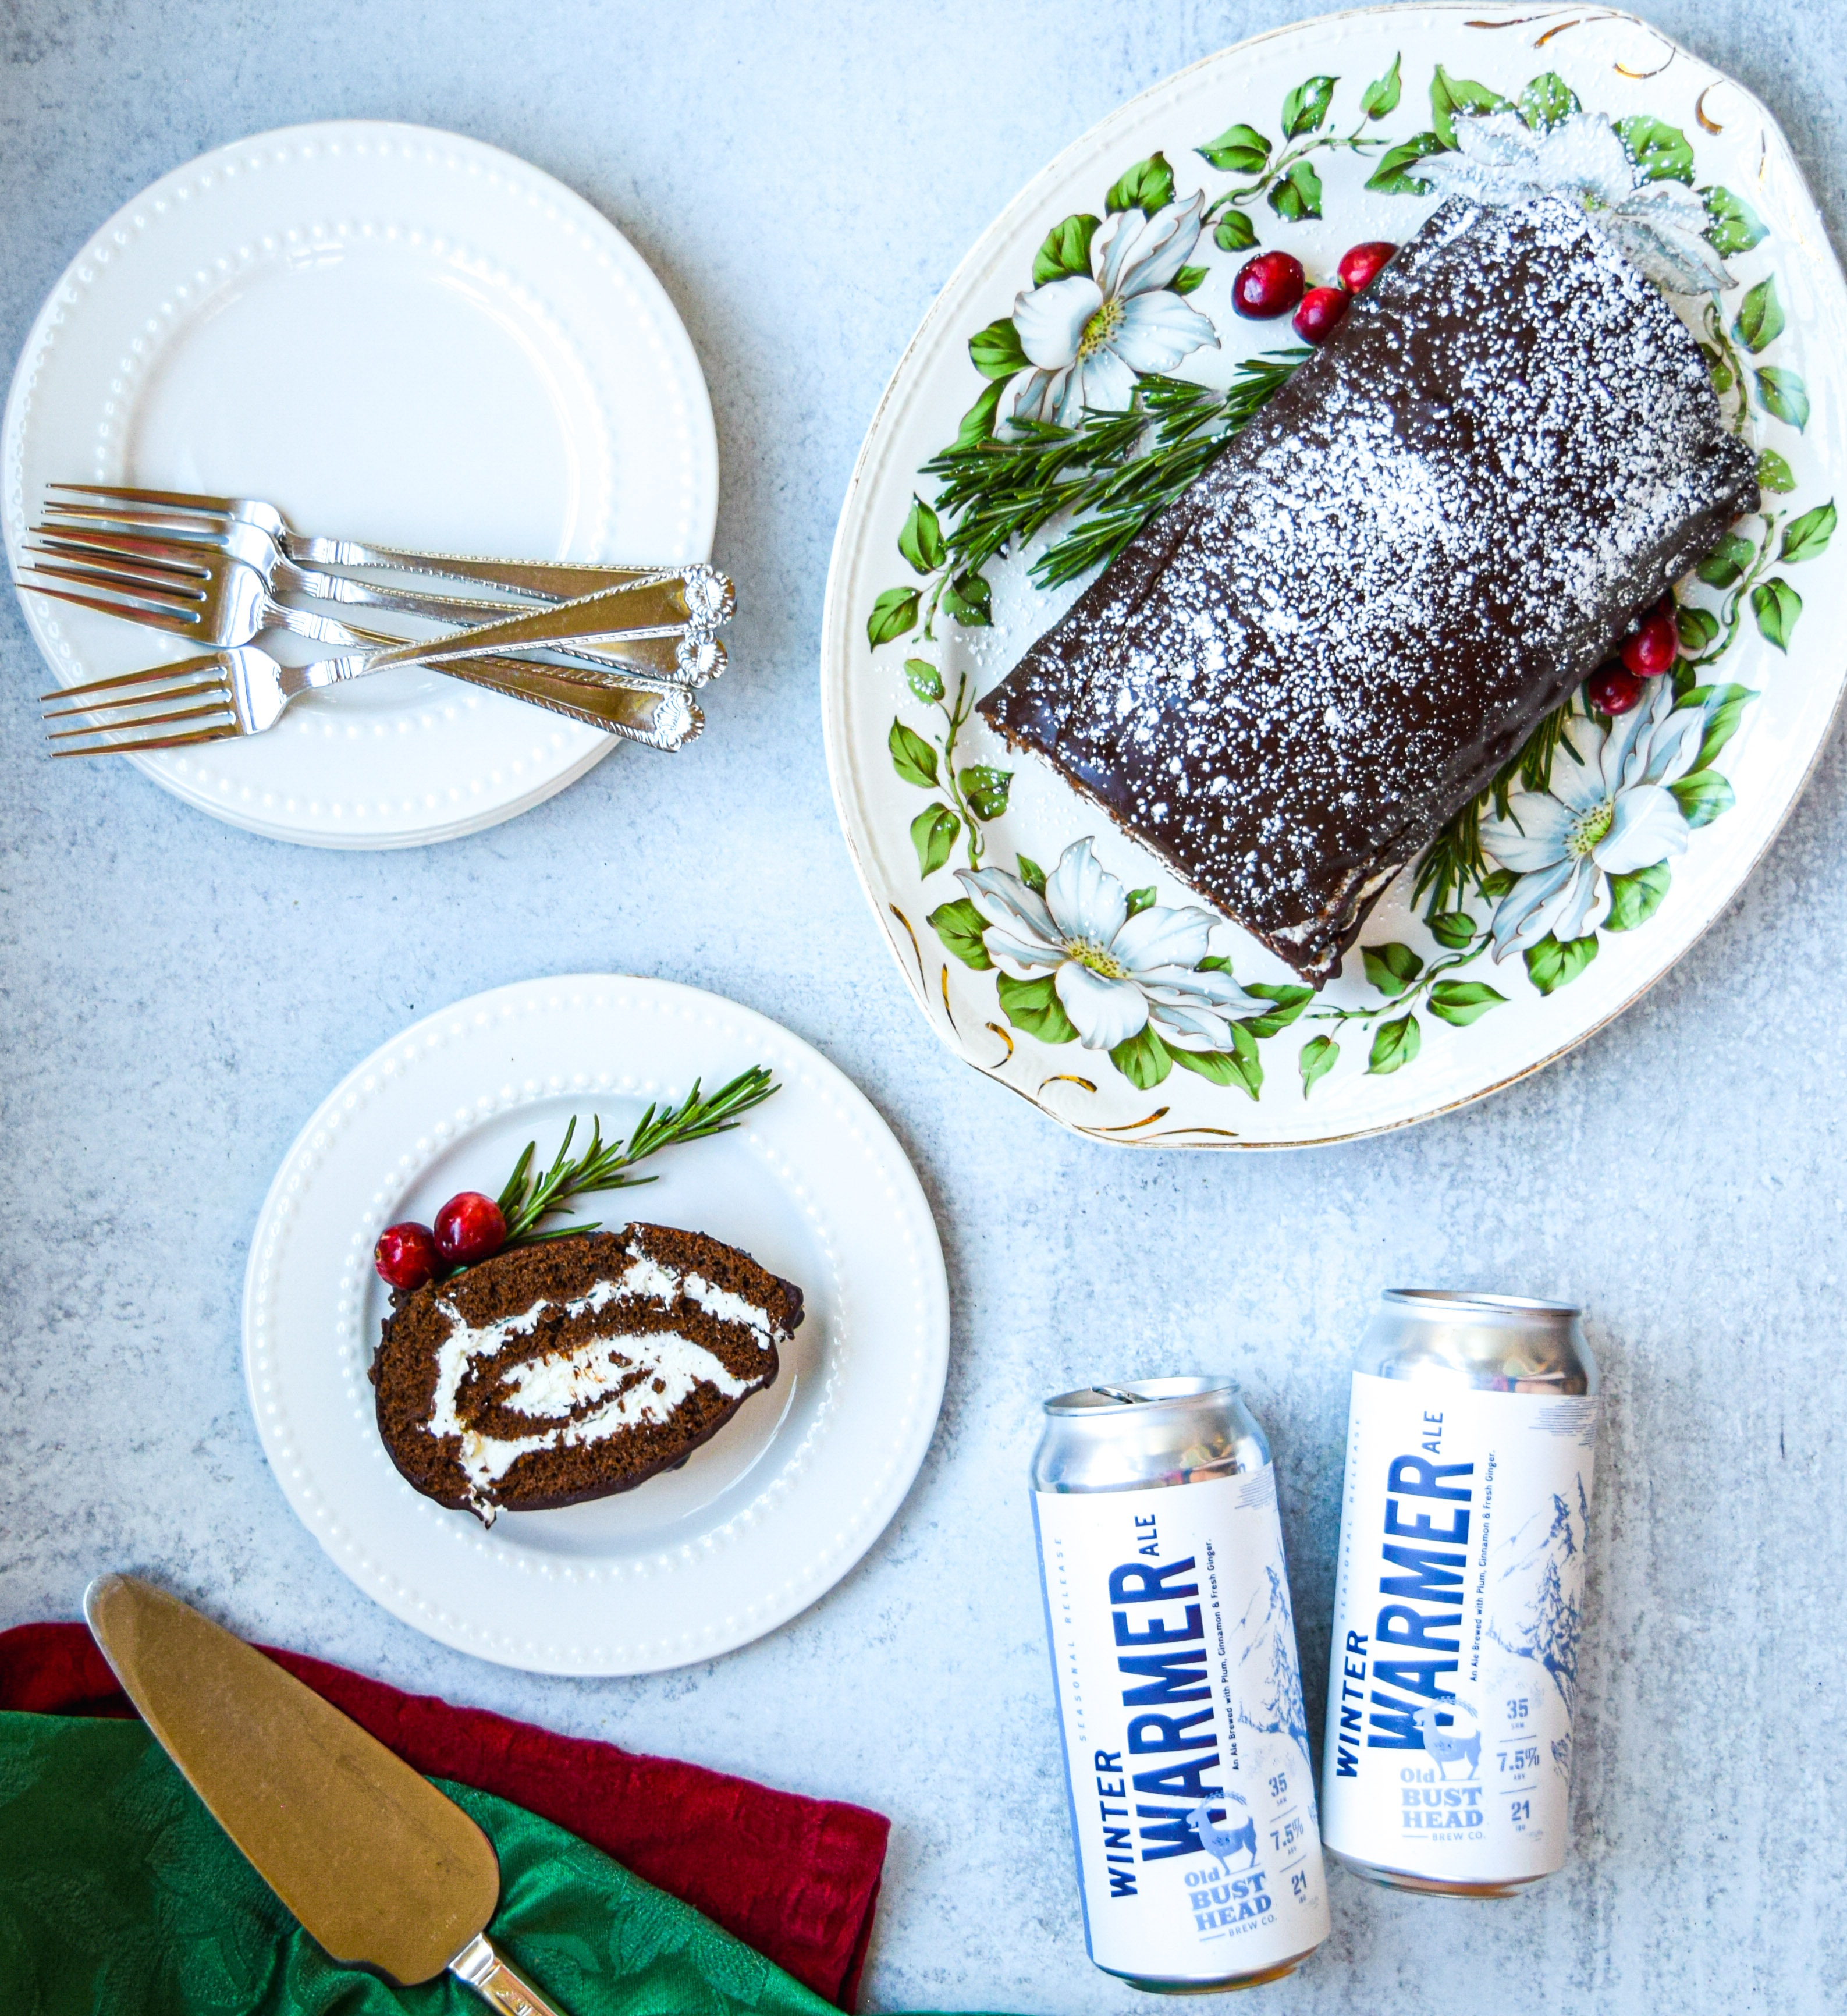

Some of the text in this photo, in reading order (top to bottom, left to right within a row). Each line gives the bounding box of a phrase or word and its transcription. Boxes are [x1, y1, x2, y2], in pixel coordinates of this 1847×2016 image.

[1485, 1450, 1497, 1482] Ginger.
[1483, 1485, 1493, 1509] Fresh
[1206, 1538, 1216, 1571] Ginger.
[1478, 1522, 1490, 1567] Cinnamon
[1209, 1573, 1218, 1598] Fresh
[1366, 1410, 1474, 1751] WARMER ALE
[1476, 1570, 1487, 1594] Plum,
[1475, 1596, 1483, 1615] with
[1054, 1538, 1086, 1741] SEASONAL RELEASE
[1215, 1611, 1226, 1656] Cinnamon
[1472, 1619, 1482, 1651] Brewed
[1221, 1659, 1229, 1683] Plum,
[1471, 1653, 1479, 1667] Ale
[1108, 1514, 1227, 1862] WARMER ALE
[1469, 1670, 1478, 1682] An
[1223, 1686, 1232, 1704] with
[1336, 1630, 1368, 1777] WINTER
[1506, 1698, 1528, 1719] 35
[1226, 1707, 1236, 1740] Brewed
[1232, 1759, 1239, 1770] An
[1496, 1746, 1540, 1772] 7.5%
[1268, 1772, 1288, 1797] 35
[1400, 1767, 1436, 1783] Old
[1400, 1786, 1483, 1807] BUST
[1402, 1809, 1484, 1829] HEAD
[1511, 1800, 1530, 1821] 21
[1095, 1749, 1138, 1898] WINTER
[1270, 1816, 1304, 1851] 7.5%
[1432, 1831, 1486, 1841] BREW CO.
[1184, 1866, 1221, 1887] Old
[1291, 1869, 1307, 1896] 21
[1188, 1871, 1266, 1911] BUST
[1194, 1894, 1272, 1932] HEAD
[1228, 1914, 1277, 1937] BREW CO.
